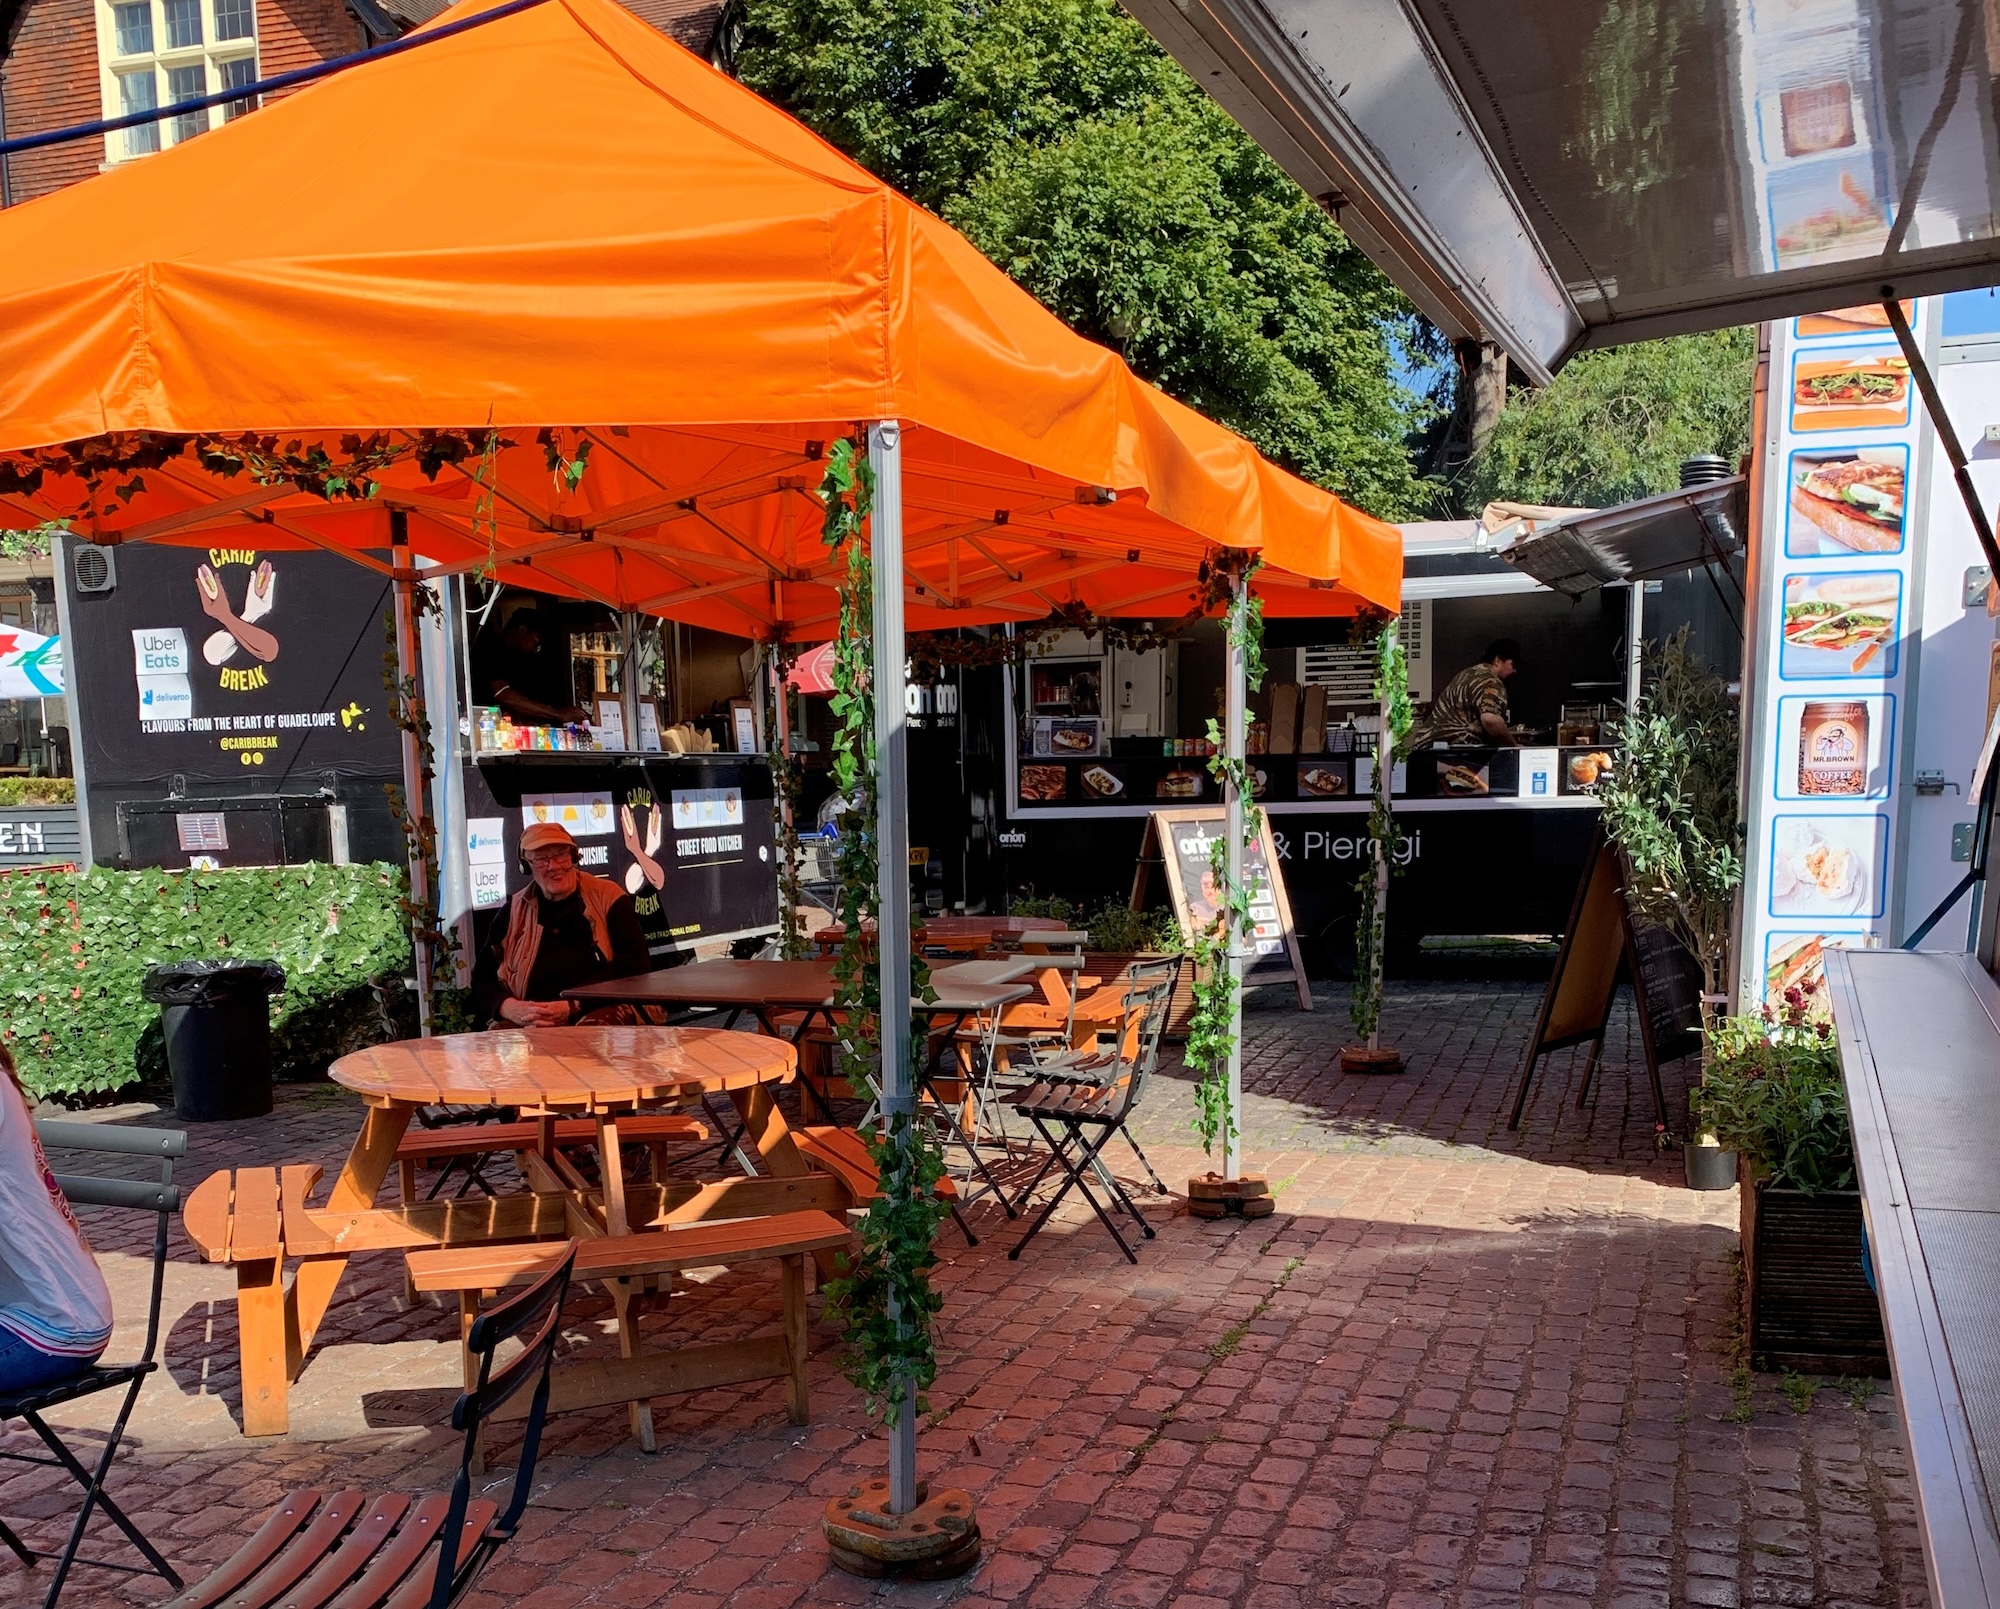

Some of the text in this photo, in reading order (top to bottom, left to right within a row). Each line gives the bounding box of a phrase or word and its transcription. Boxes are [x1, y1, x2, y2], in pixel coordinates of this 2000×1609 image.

[143, 637, 178, 651] Uber
[144, 654, 180, 669] Eats
[219, 665, 269, 691] BREAK
[155, 693, 190, 702] deliveroo
[142, 712, 337, 734] FLAVOURS FROM THE HEART OF GUADELOUPE
[220, 736, 278, 750] @CARIBBREAK
[1812, 770, 1853, 780] COFFEE
[626, 787, 652, 809] CARIB
[477, 837, 501, 847] deliveroo
[676, 834, 743, 857] STREET FOOD KITCHEN
[578, 846, 609, 866] CUISINE
[475, 872, 499, 886] Uber
[476, 889, 500, 904] Eats
[634, 894, 661, 916] BREAK
